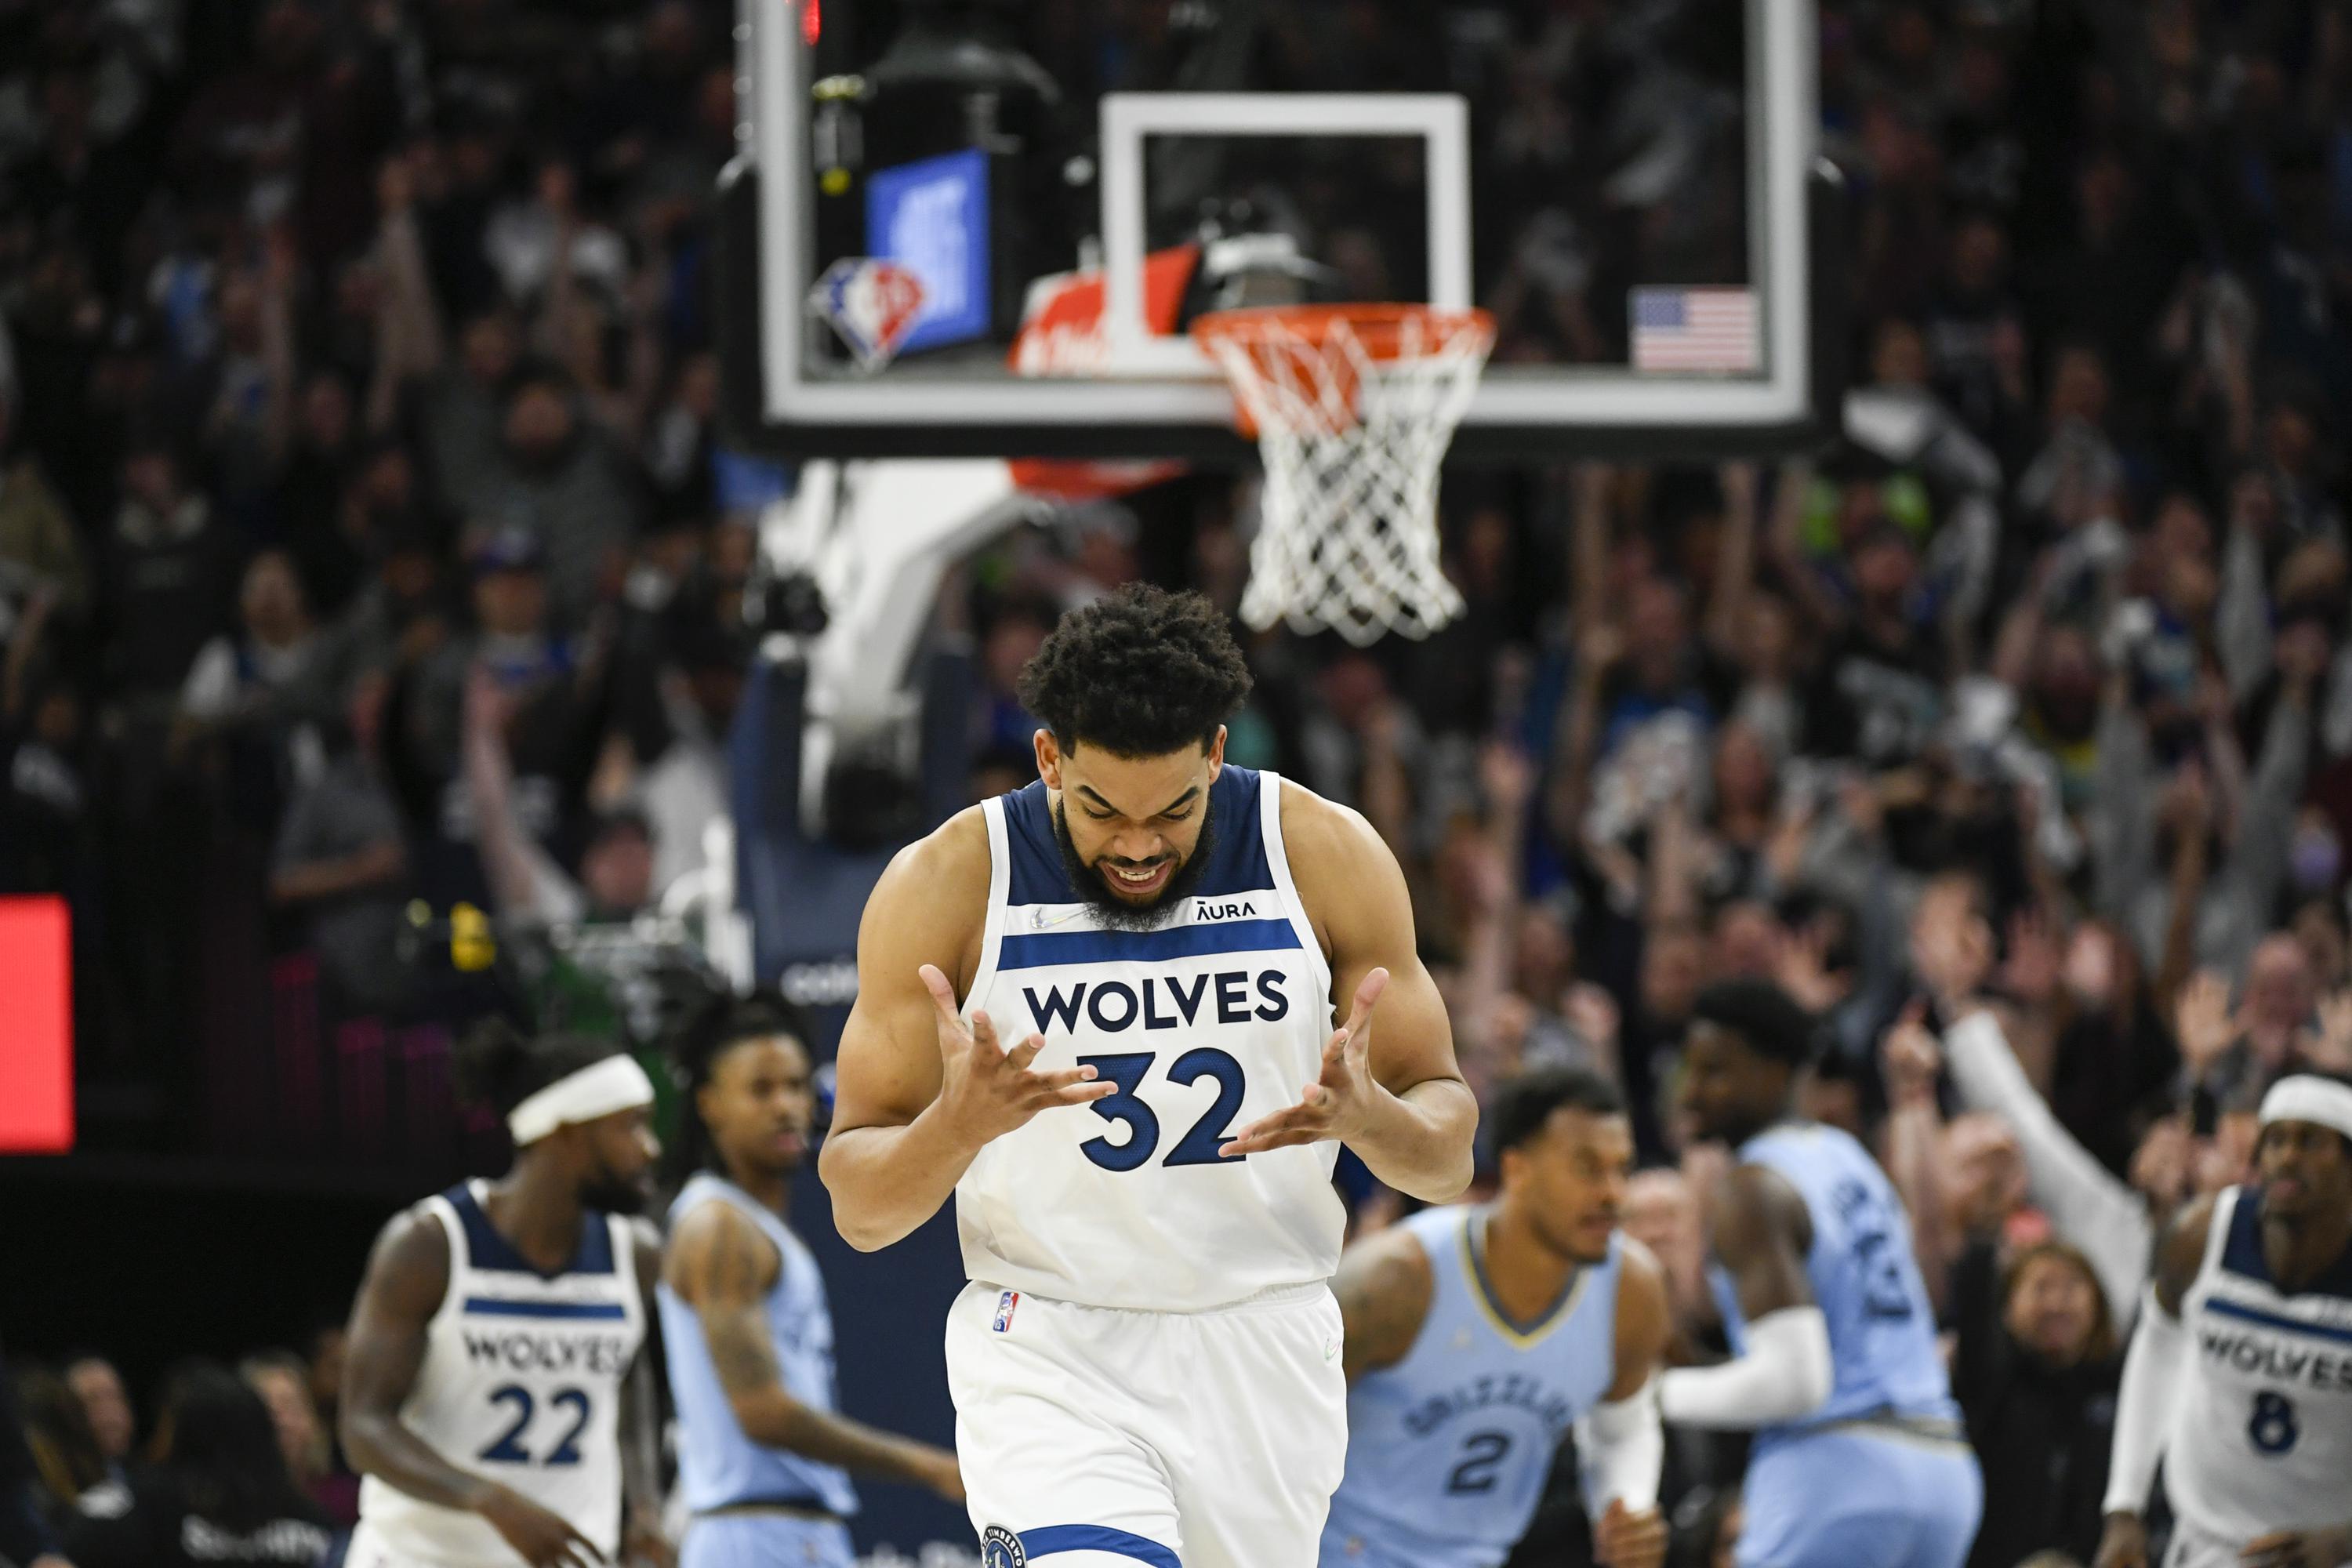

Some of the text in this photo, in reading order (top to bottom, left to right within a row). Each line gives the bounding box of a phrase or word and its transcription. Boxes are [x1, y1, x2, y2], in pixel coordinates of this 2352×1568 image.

[1022, 970, 1289, 1035] WOLVES
[1076, 1047, 1246, 1172] 32
[463, 1330, 625, 1374] WOLVES
[477, 1384, 590, 1465] 22
[2247, 1388, 2299, 1456] 8
[1445, 1430, 1513, 1494] 2
